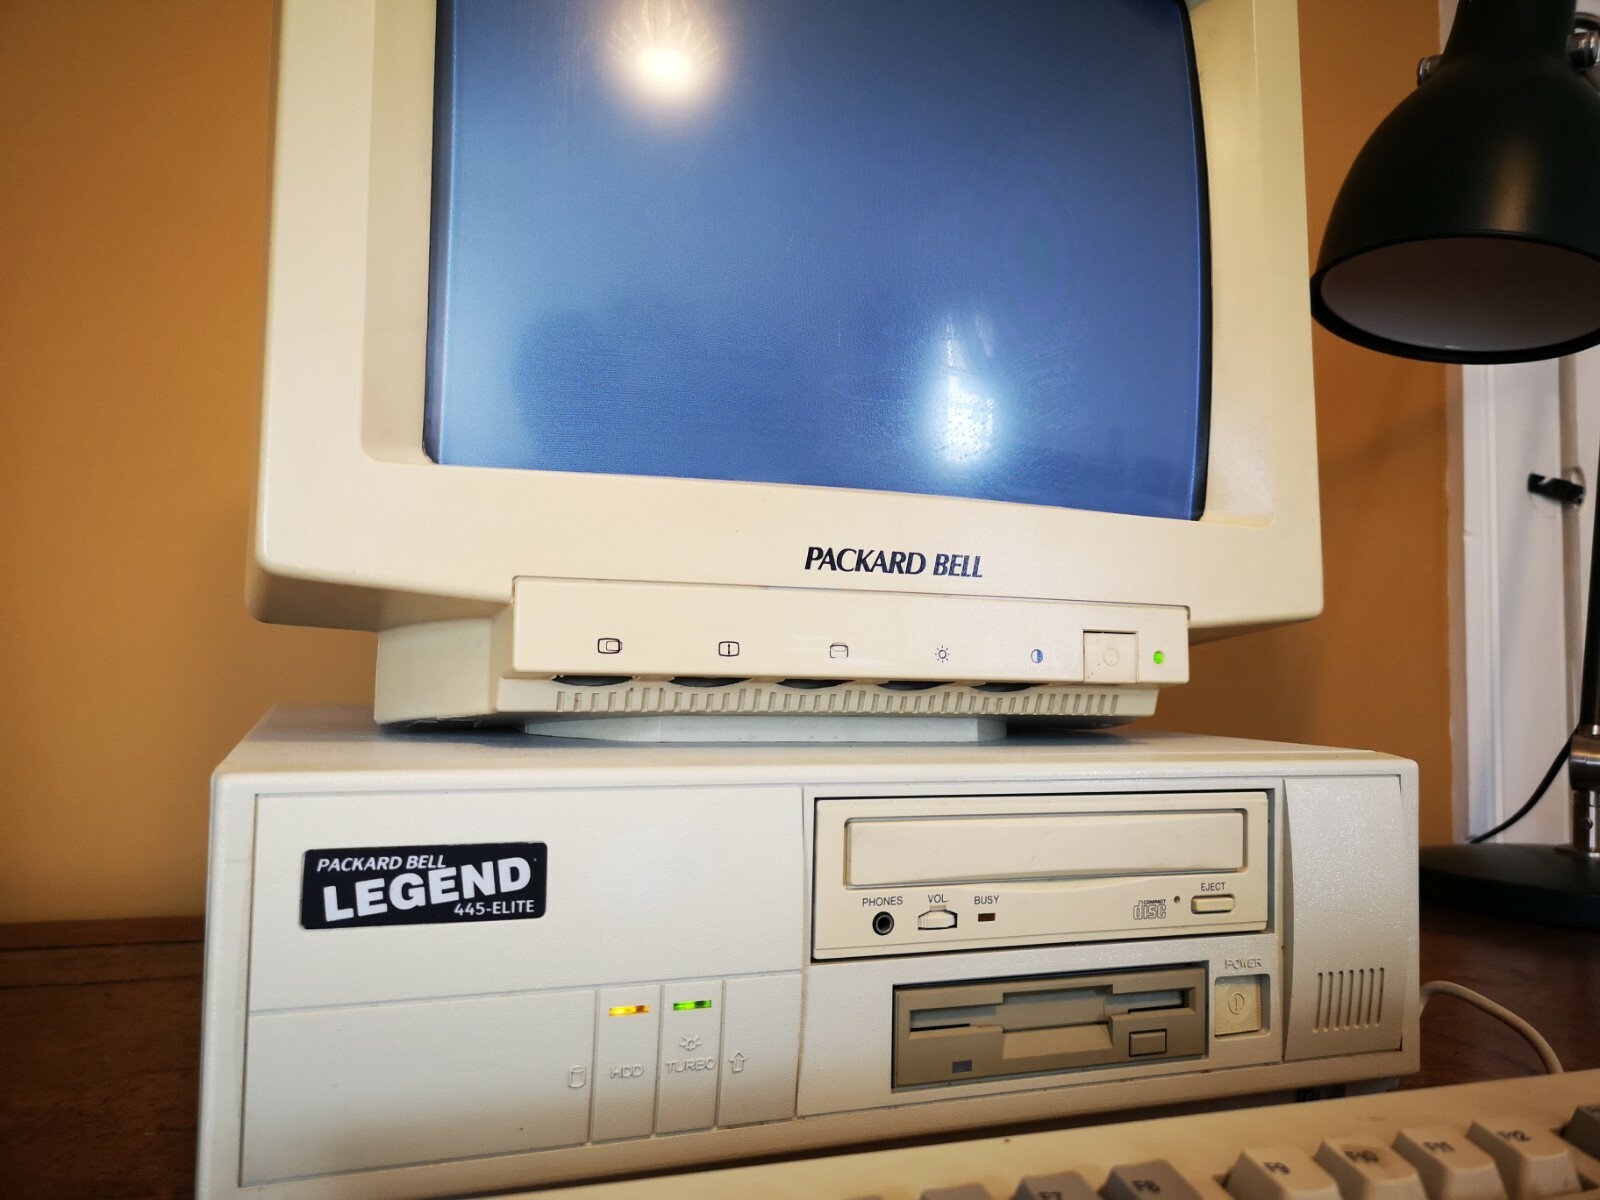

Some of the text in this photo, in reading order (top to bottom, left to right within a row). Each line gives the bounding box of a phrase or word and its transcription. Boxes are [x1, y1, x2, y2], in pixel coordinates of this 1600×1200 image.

[804, 546, 983, 578] PACKARD BELL
[316, 855, 447, 872] PACKARD BELL
[323, 857, 532, 922] LEGEND
[1200, 882, 1226, 892] EJECT
[454, 900, 535, 916] 445-ELITE
[862, 896, 904, 907] PHONES
[974, 895, 1000, 905] BUSY
[1224, 958, 1263, 970] POWER
[611, 1064, 645, 1080] HDD
[665, 1058, 717, 1074] TURBO
